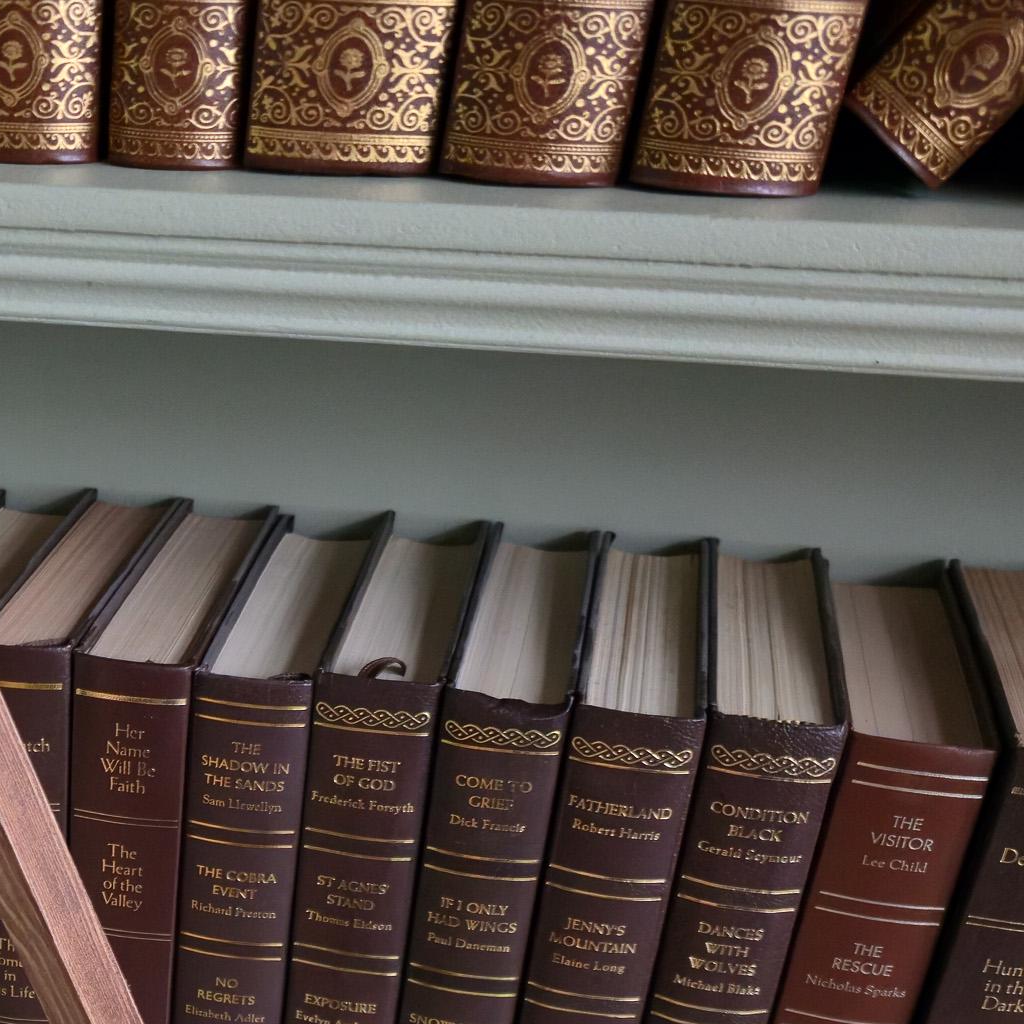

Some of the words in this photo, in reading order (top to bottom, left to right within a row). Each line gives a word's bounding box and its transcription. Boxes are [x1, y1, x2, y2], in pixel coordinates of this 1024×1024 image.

[115, 723, 145, 740] Her
[106, 742, 151, 758] Name
[232, 742, 261, 756] THE
[100, 757, 132, 776] Will
[137, 762, 156, 778] Be
[202, 754, 268, 774] SHADOW
[273, 762, 290, 775] IN
[332, 754, 364, 772] THE
[368, 759, 402, 774] FIST
[110, 777, 146, 795] Faith
[204, 774, 231, 788] THE
[234, 778, 285, 792] SANDS
[333, 774, 354, 786] OF
[358, 778, 396, 792] GOD
[456, 774, 503, 791] COME
[202, 794, 225, 808] Sam
[311, 791, 364, 810] Frederick
[568, 794, 673, 821] FATHERLAND
[710, 801, 810, 824] CONDITION
[449, 814, 478, 829] Dick
[482, 819, 526, 834] Francis
[572, 818, 616, 836] Robert
[618, 827, 660, 842] Harris
[892, 816, 924, 832] THE
[727, 824, 784, 843] BLACK
[870, 832, 934, 852] VISITOR
[106, 843, 137, 860] The
[102, 860, 144, 876] Heart
[862, 854, 887, 869] Lee
[890, 858, 928, 874] Child
[196, 864, 222, 880] THE
[226, 870, 278, 884] COBRA
[316, 875, 335, 888] ST
[103, 877, 118, 890] of
[120, 879, 143, 894] the
[212, 884, 258, 900] EVENT
[102, 891, 142, 912] Valley
[191, 899, 232, 917] Richard
[326, 894, 375, 911] STAND
[440, 896, 455, 909] IF
[466, 902, 509, 916] ONLY
[427, 912, 462, 928] HAD
[465, 919, 518, 934] WINGS
[698, 922, 764, 942] DANCES
[427, 932, 452, 947] Paul
[456, 938, 511, 953] Daneman
[549, 932, 638, 954] MOUNTAIN
[704, 942, 750, 958] WITH
[852, 942, 884, 958] THE
[552, 953, 590, 970] Elaine
[592, 960, 626, 975] Long
[688, 956, 758, 977] WOLVES
[832, 958, 894, 978] RESCUE
[4, 970, 16, 981] in
[216, 976, 238, 990] NO
[673, 974, 724, 994] Michael
[11, 985, 35, 998] Life
[984, 980, 1001, 995] in
[197, 989, 256, 1006] REGRETS
[304, 993, 377, 1014] EXPOSURE
